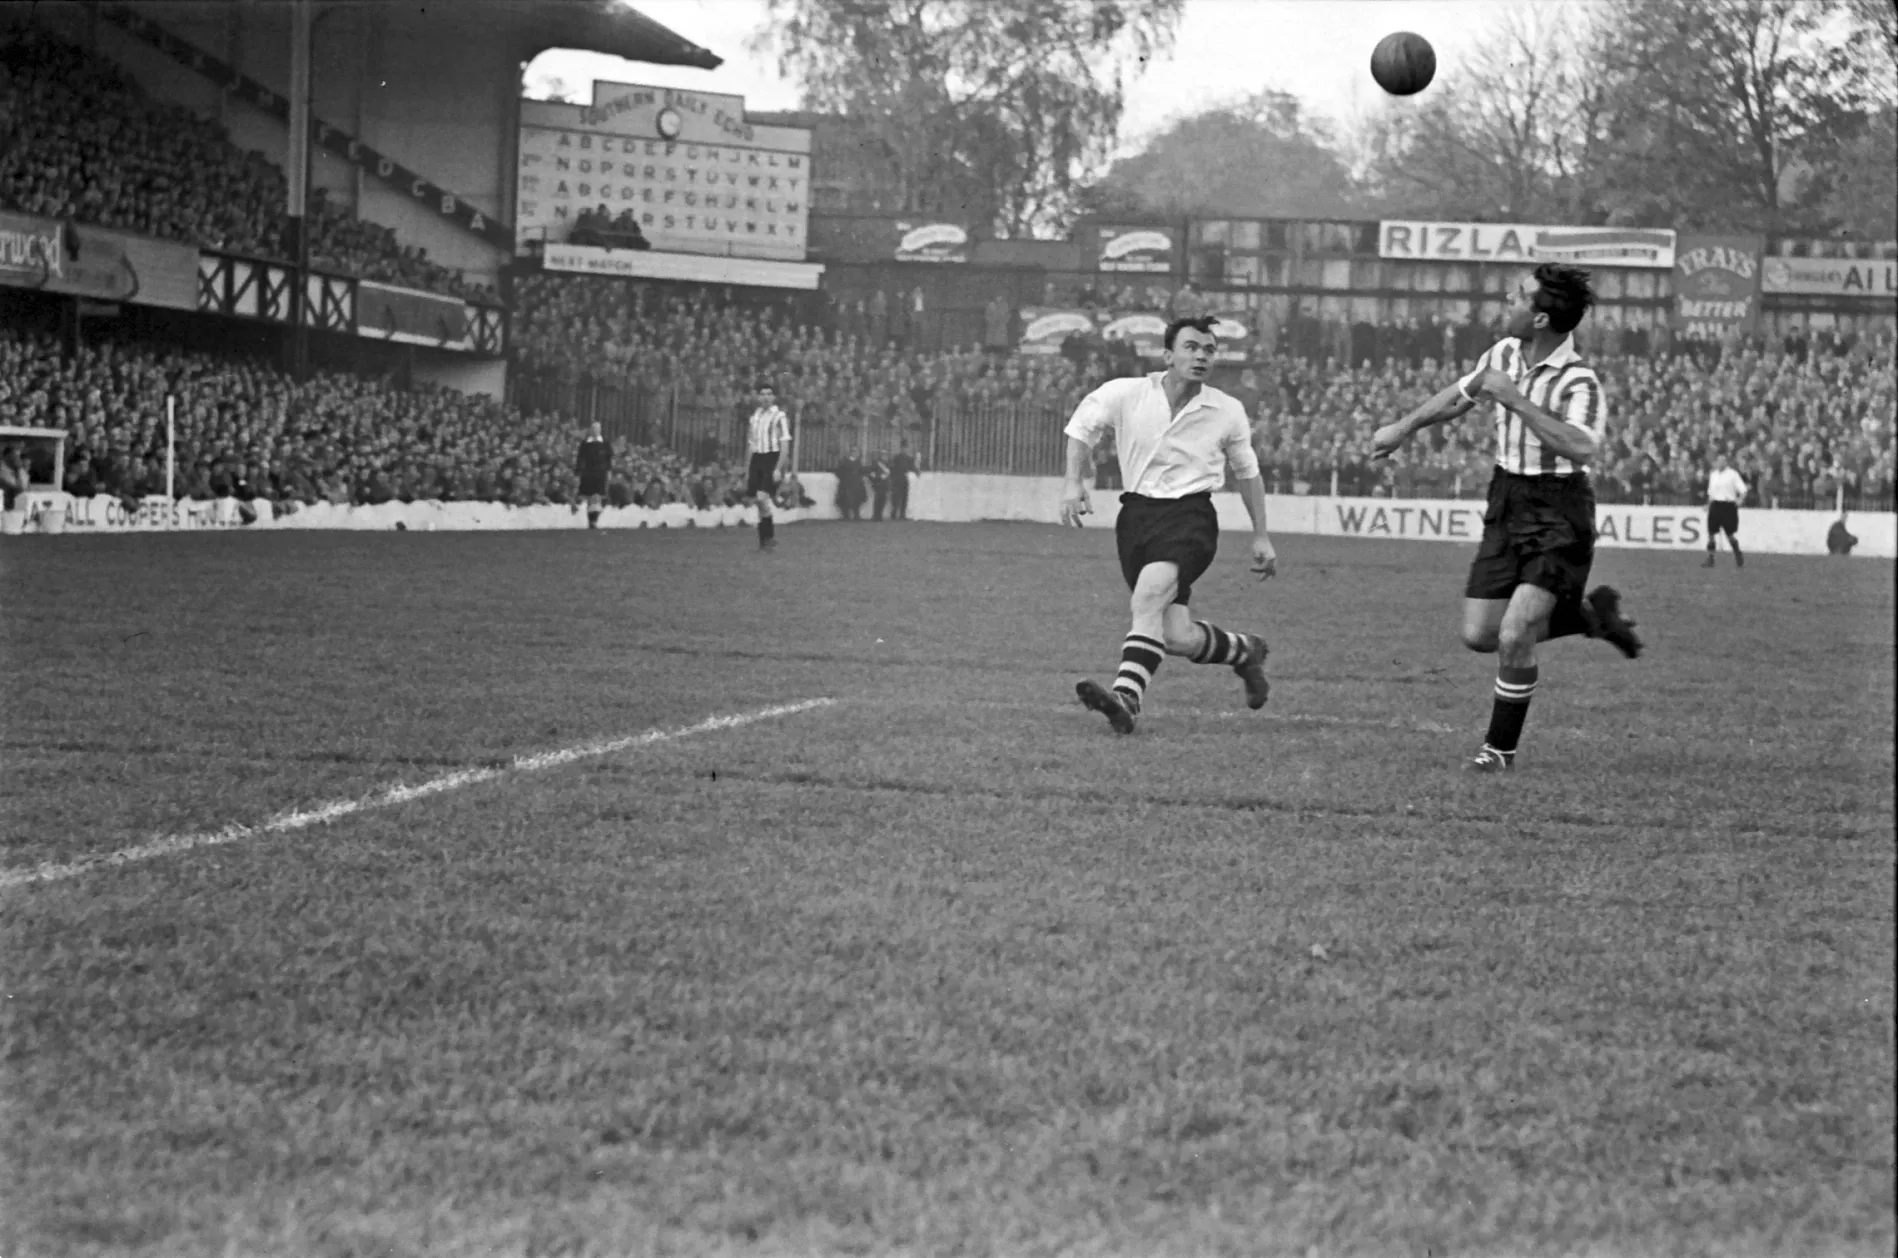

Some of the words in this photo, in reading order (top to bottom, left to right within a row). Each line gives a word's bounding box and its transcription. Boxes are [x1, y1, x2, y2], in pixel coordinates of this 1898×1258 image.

[412, 180, 425, 197] C
[441, 195, 456, 214] B
[470, 212, 486, 231] A
[1384, 225, 1524, 257] RIZLA
[65, 501, 95, 526] ALL
[106, 501, 180, 526] COOPERS
[1596, 514, 1701, 543] ALES
